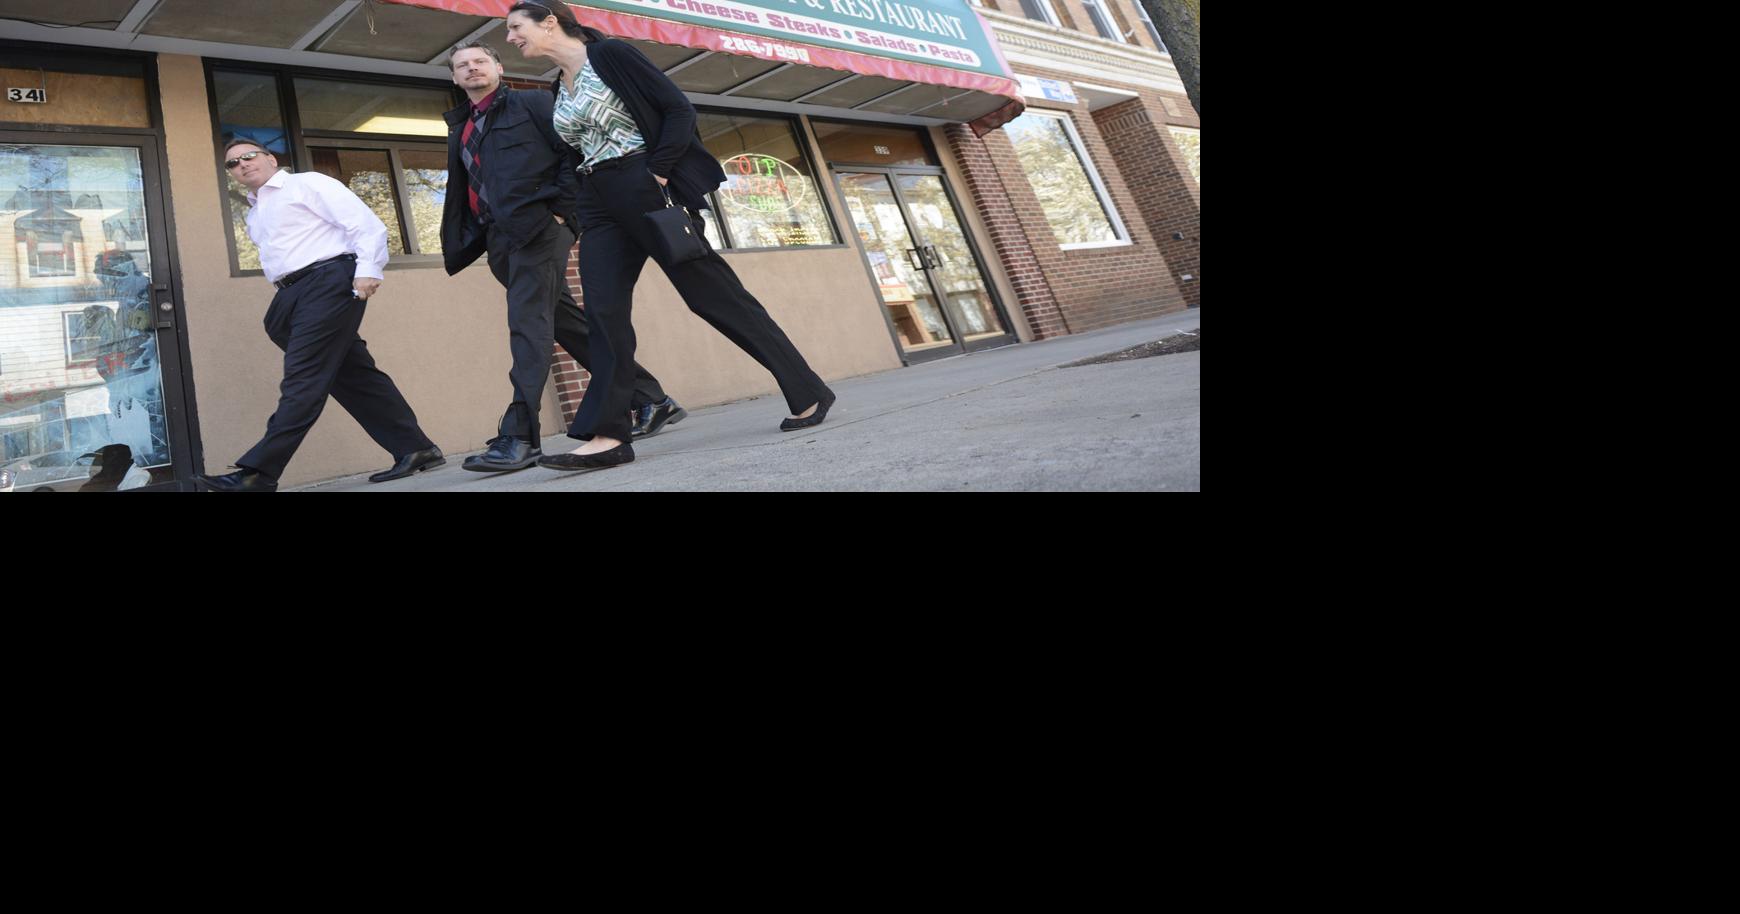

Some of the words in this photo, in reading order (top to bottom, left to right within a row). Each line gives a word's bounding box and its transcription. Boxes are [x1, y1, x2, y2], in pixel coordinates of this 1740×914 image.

[666, 0, 759, 24] Cheese
[766, 13, 841, 39] Steaks
[855, 30, 918, 53] Salads
[928, 44, 974, 63] Pasta
[831, 0, 967, 40] RESTAURANT
[10, 88, 44, 101] 341
